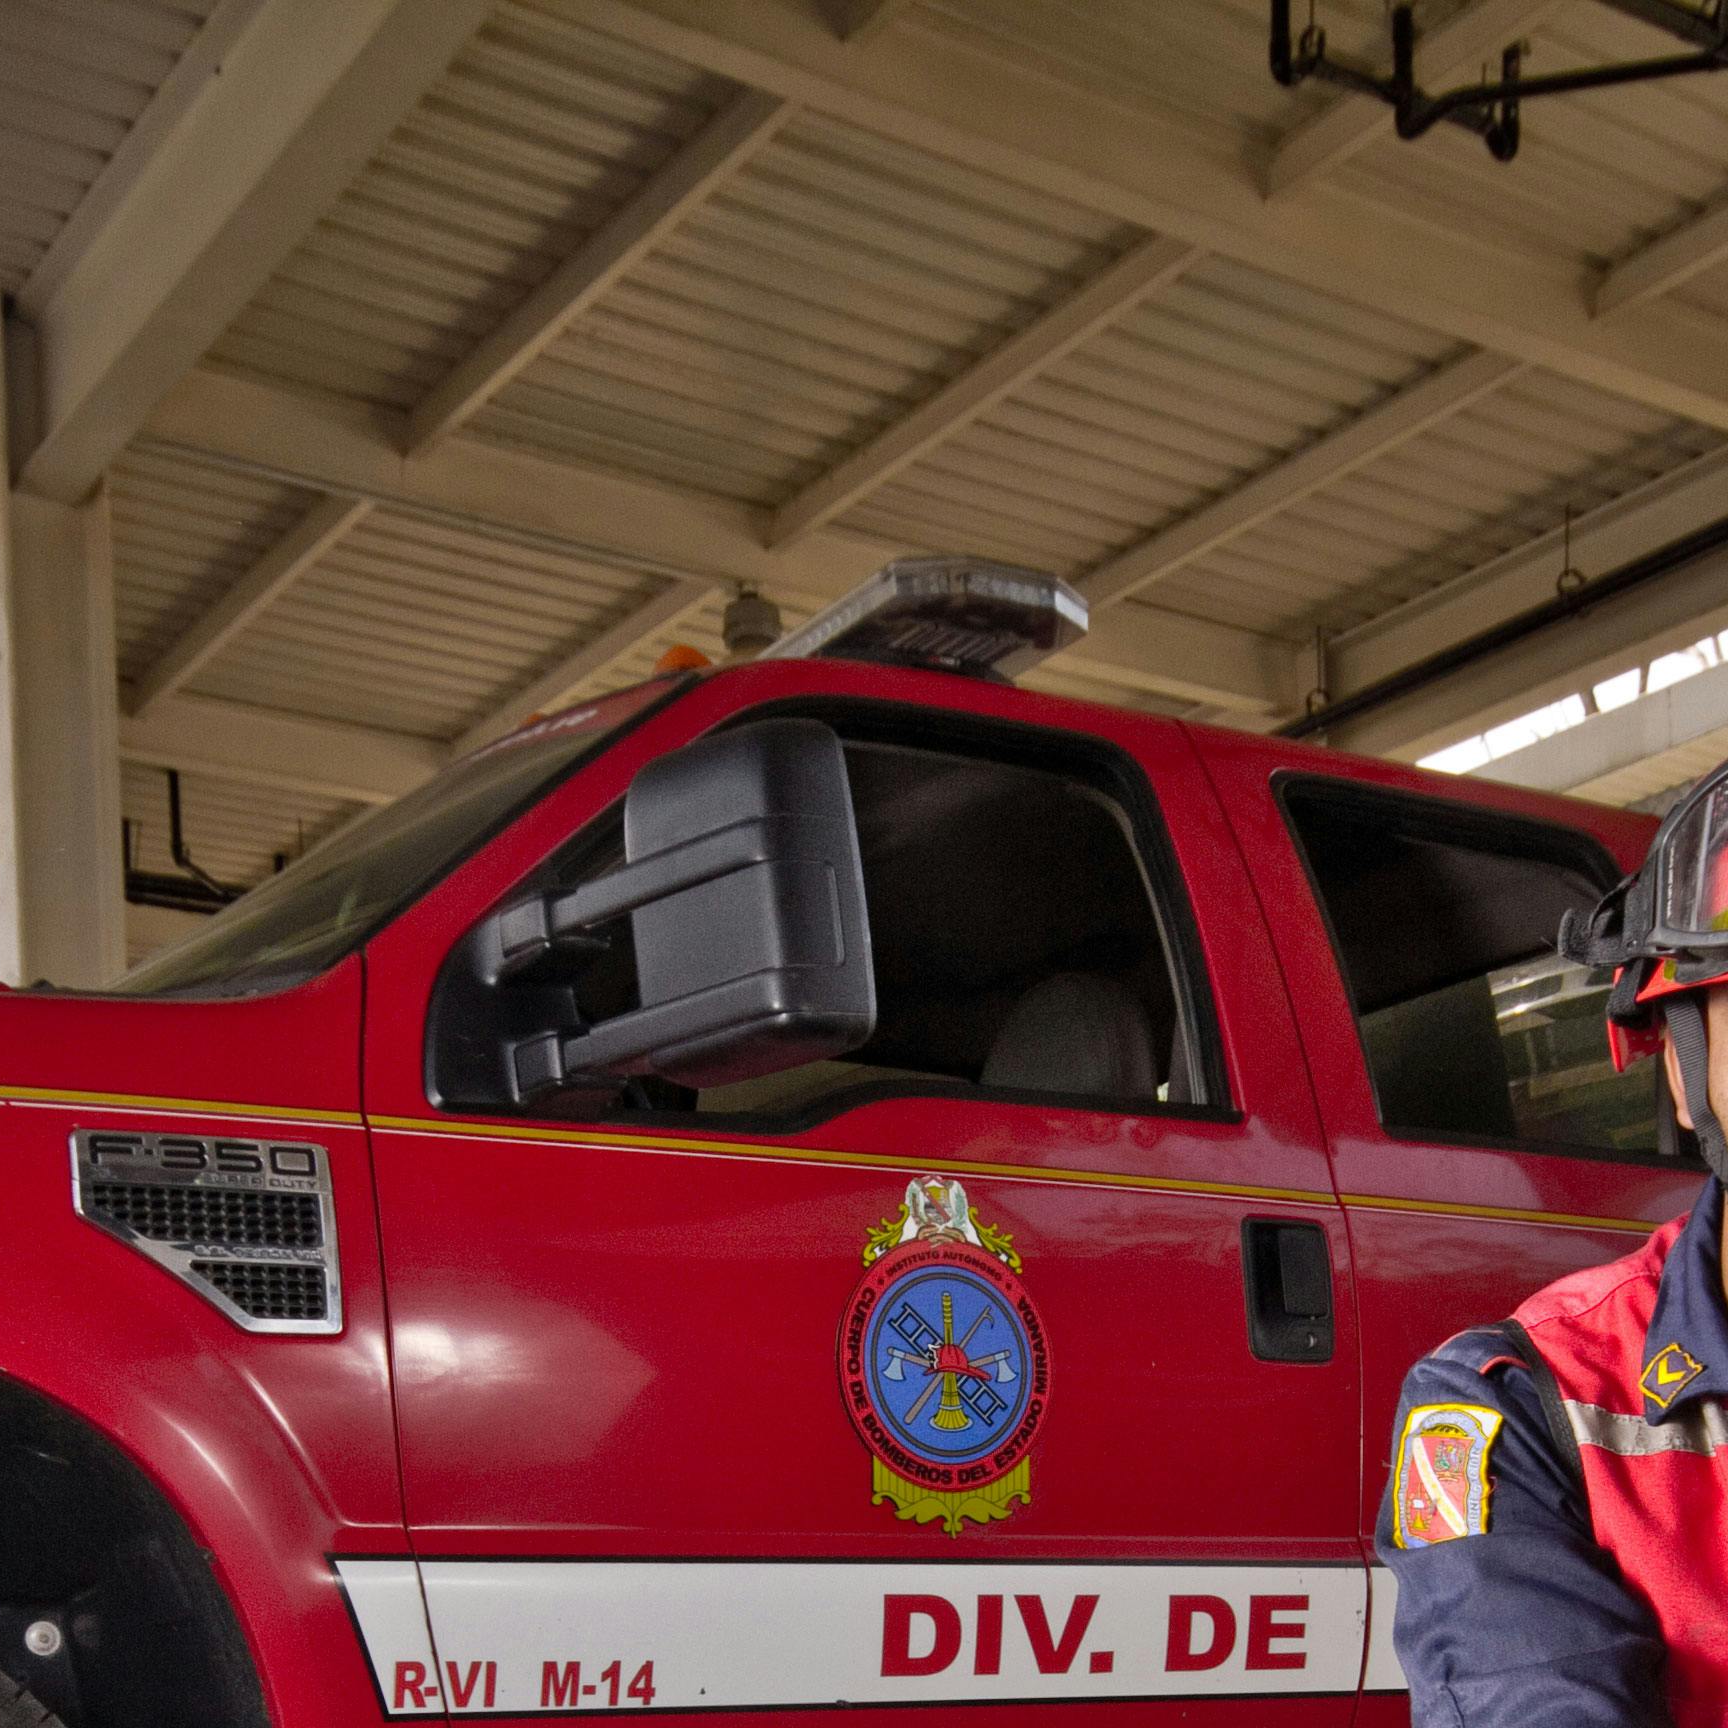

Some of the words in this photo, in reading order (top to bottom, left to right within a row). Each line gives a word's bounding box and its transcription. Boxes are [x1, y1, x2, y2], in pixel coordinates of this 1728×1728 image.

[89, 1135, 316, 1176] F-350
[269, 1177, 317, 1190] DUTY
[885, 1250, 940, 1277] INSTITUTO
[846, 1286, 876, 1376] CUERPO
[1017, 1295, 1049, 1395] MIRANDA
[849, 1381, 869, 1412] DE
[861, 1412, 953, 1485] BOMBEROS
[994, 1399, 1043, 1469] ESTADO
[957, 1463, 992, 1485] DEL
[880, 1594, 1115, 1677] DIV.
[1165, 1594, 1310, 1672] DE
[393, 1661, 497, 1708] R-VI
[540, 1660, 656, 1707] M-14
